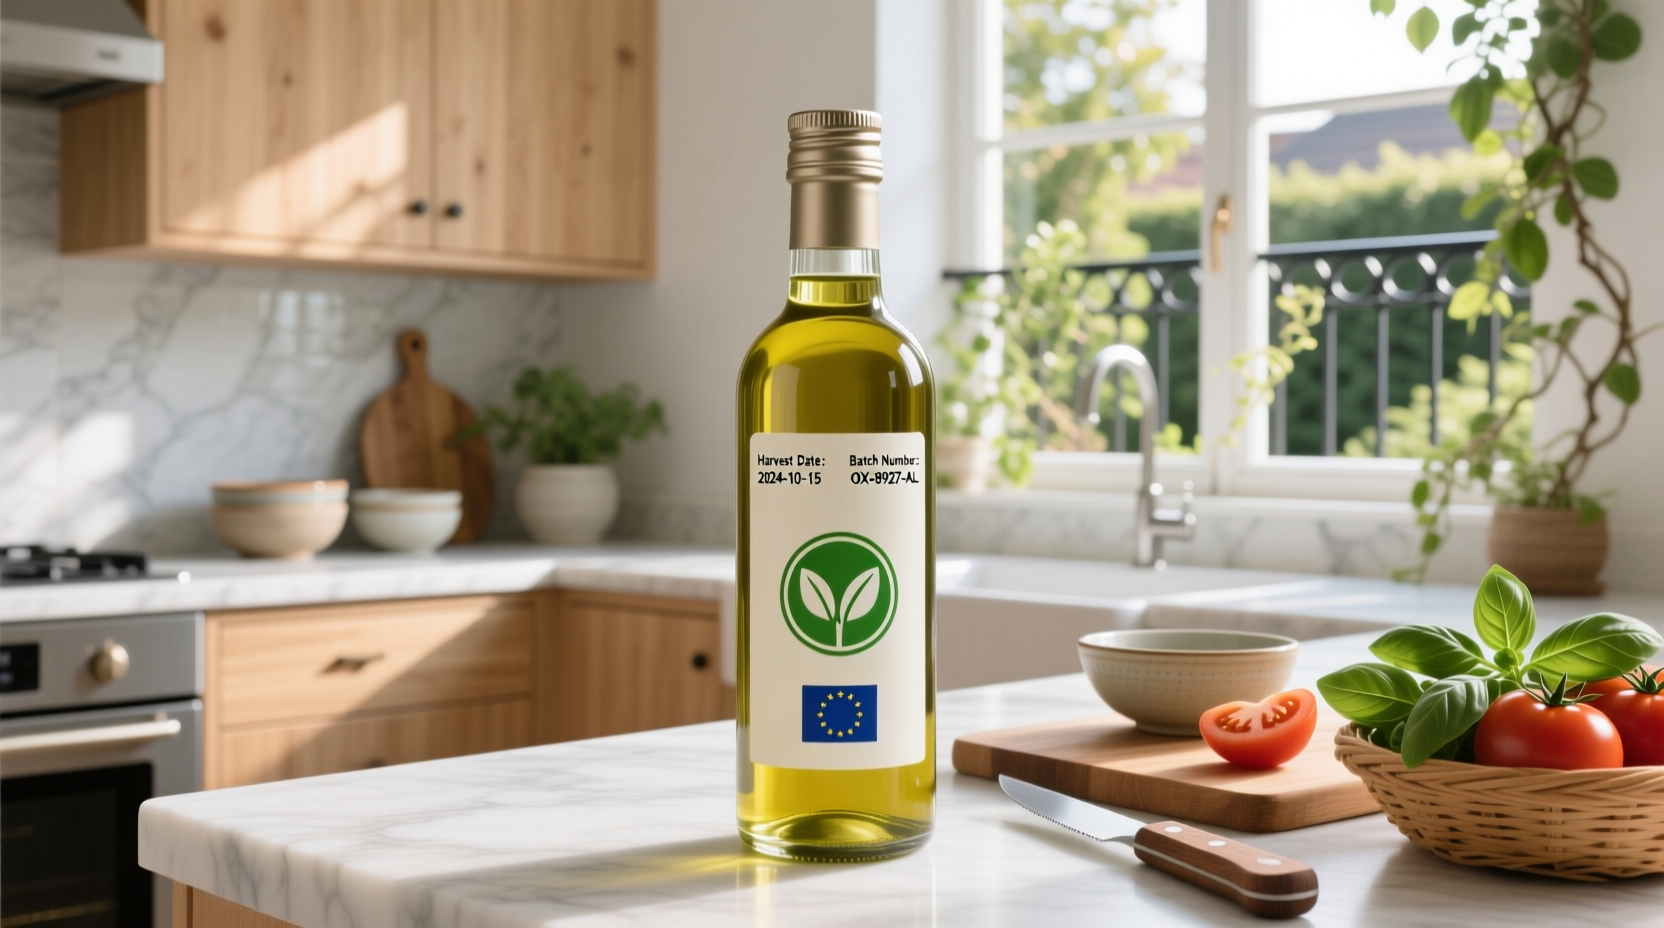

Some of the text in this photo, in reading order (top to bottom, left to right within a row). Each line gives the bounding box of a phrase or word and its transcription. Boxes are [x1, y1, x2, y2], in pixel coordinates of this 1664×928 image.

[757, 454, 826, 467] Harvest Date:
[849, 454, 879, 467] Batch
[757, 471, 822, 485] 2024-10-15
[850, 471, 920, 485] OX-8927-AL
